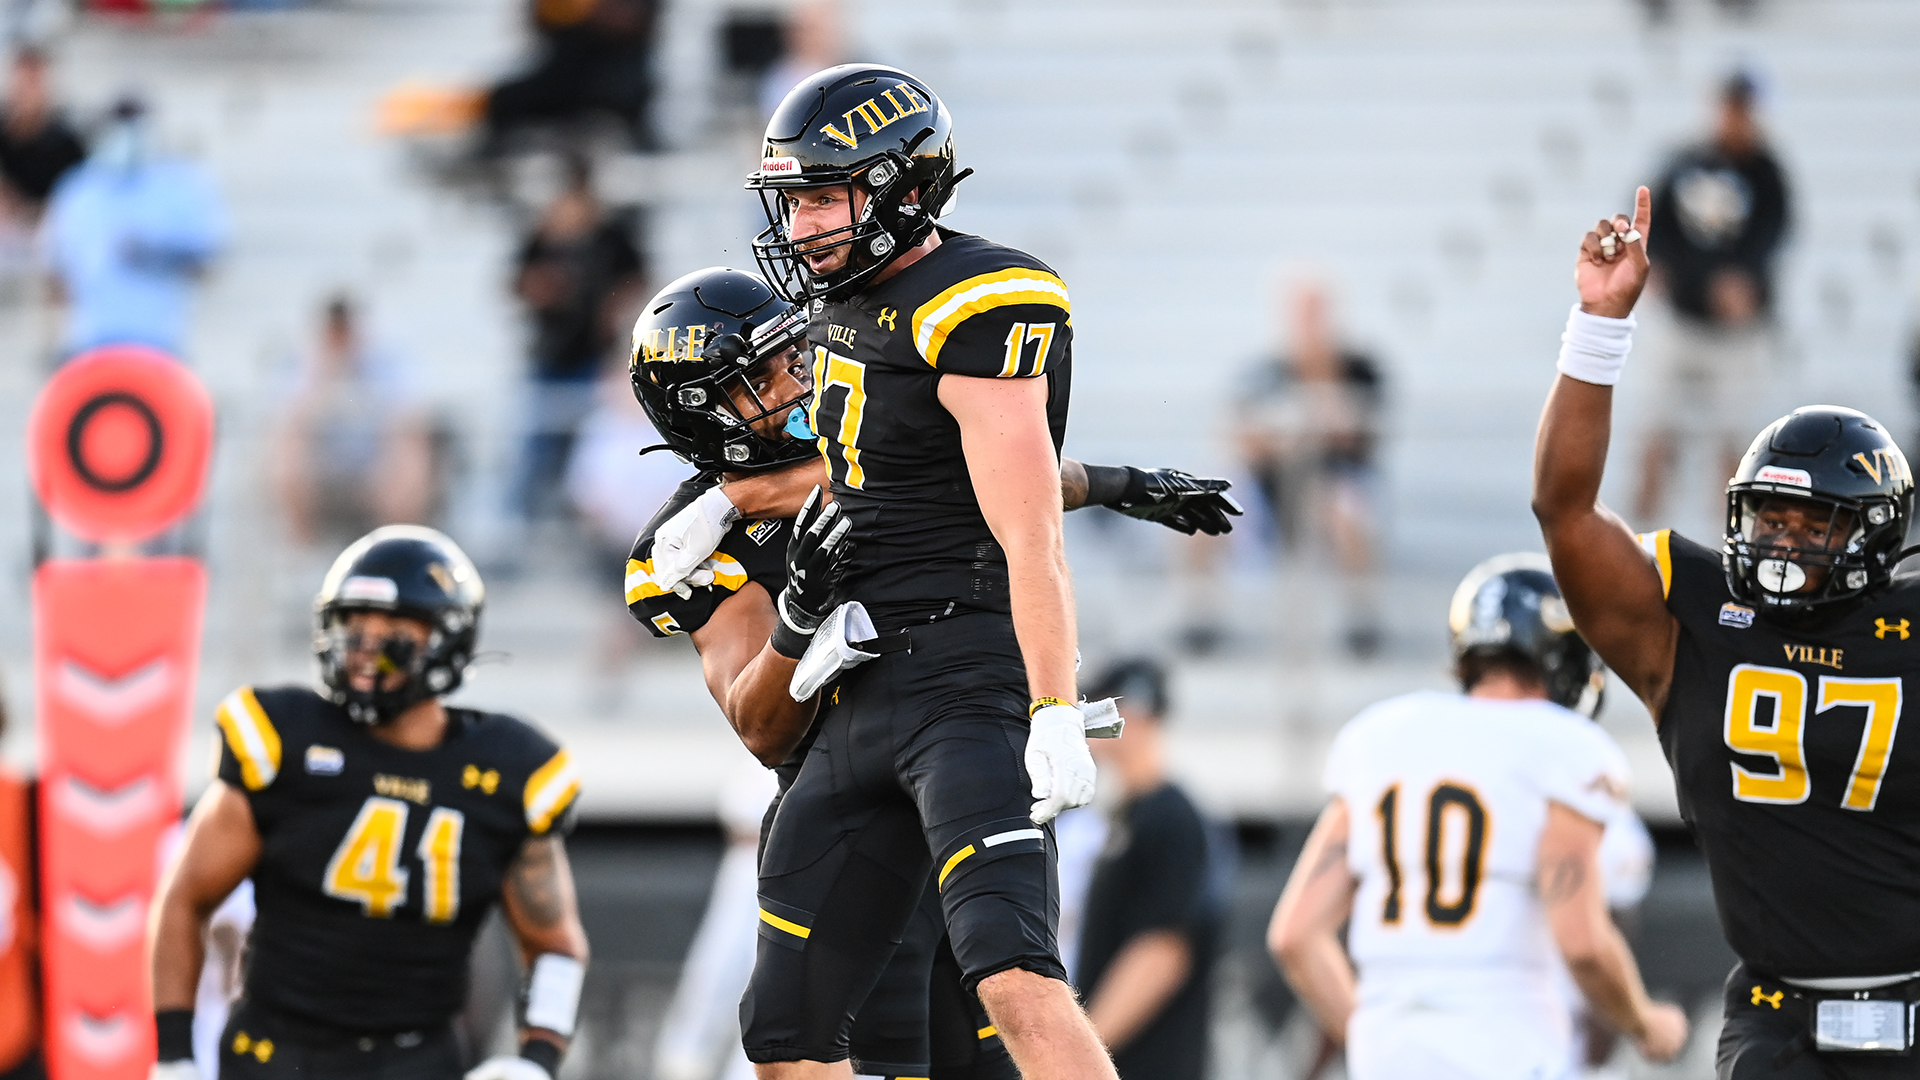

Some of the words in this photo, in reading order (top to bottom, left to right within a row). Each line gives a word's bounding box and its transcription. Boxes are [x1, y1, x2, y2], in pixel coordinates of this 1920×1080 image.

[820, 82, 928, 150] VILLE
[762, 160, 793, 171] Riddell
[633, 324, 706, 364] ILLE
[827, 323, 858, 350] VILLE
[998, 322, 1056, 377] 17
[809, 344, 868, 491] 17
[1783, 643, 1844, 670] VILLE
[1722, 662, 1903, 811] 97
[322, 796, 464, 924] 41
[1374, 778, 1491, 930] 10
